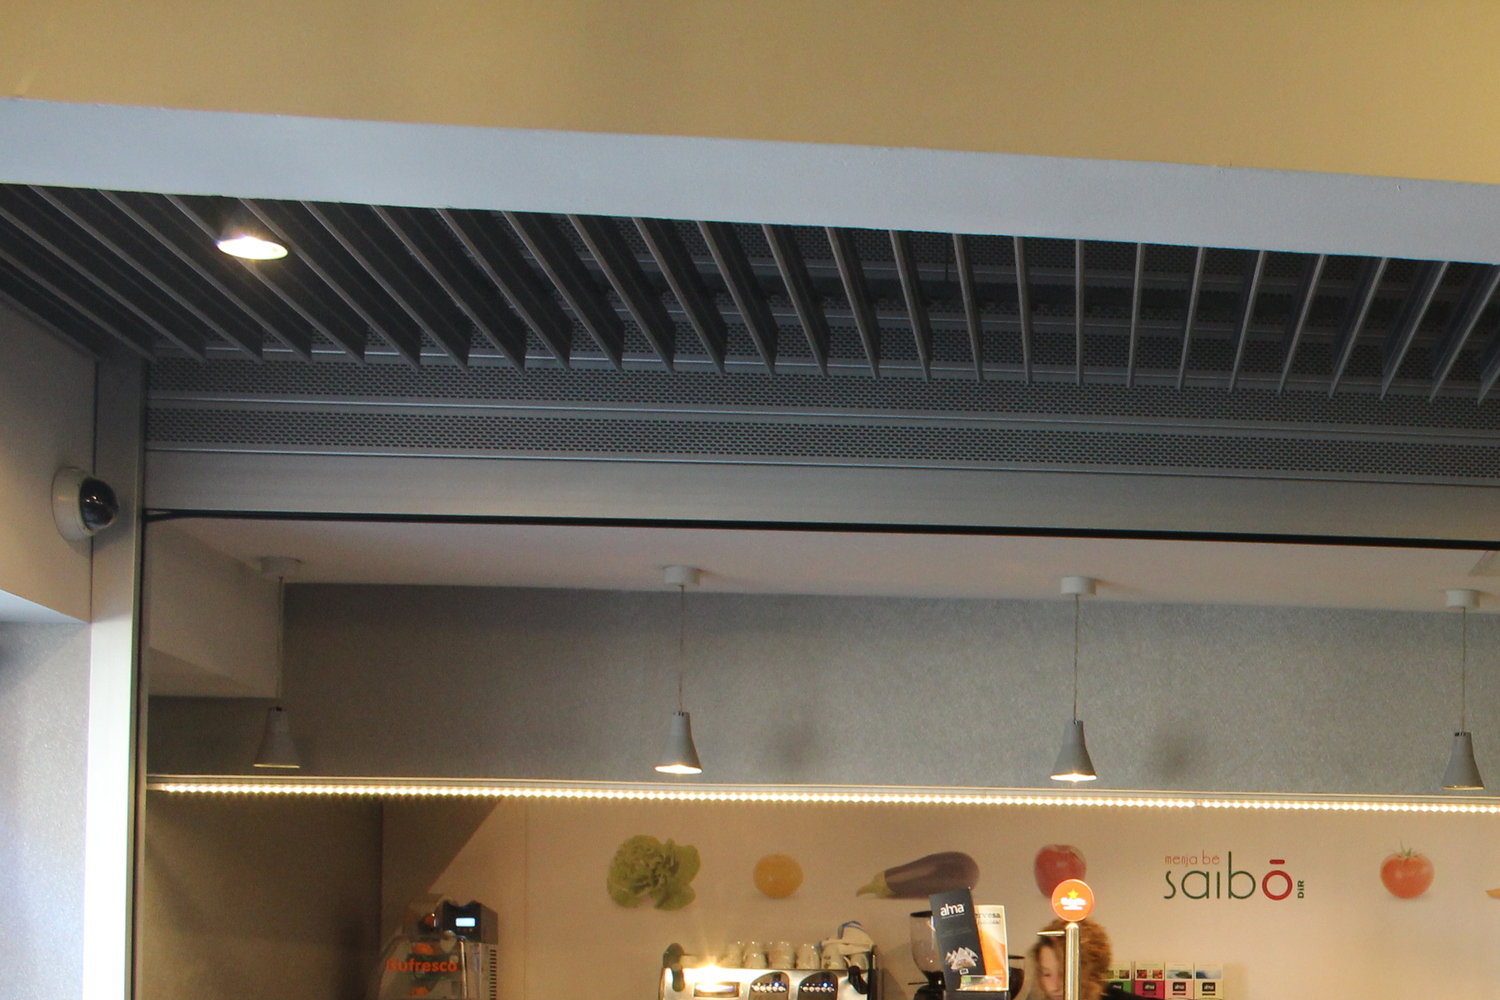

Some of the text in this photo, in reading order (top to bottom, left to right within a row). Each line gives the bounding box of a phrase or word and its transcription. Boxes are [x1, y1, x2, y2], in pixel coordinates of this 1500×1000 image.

[1164, 855, 1198, 867] menja
[940, 903, 965, 916] alma
[386, 958, 459, 972] Gufresco
